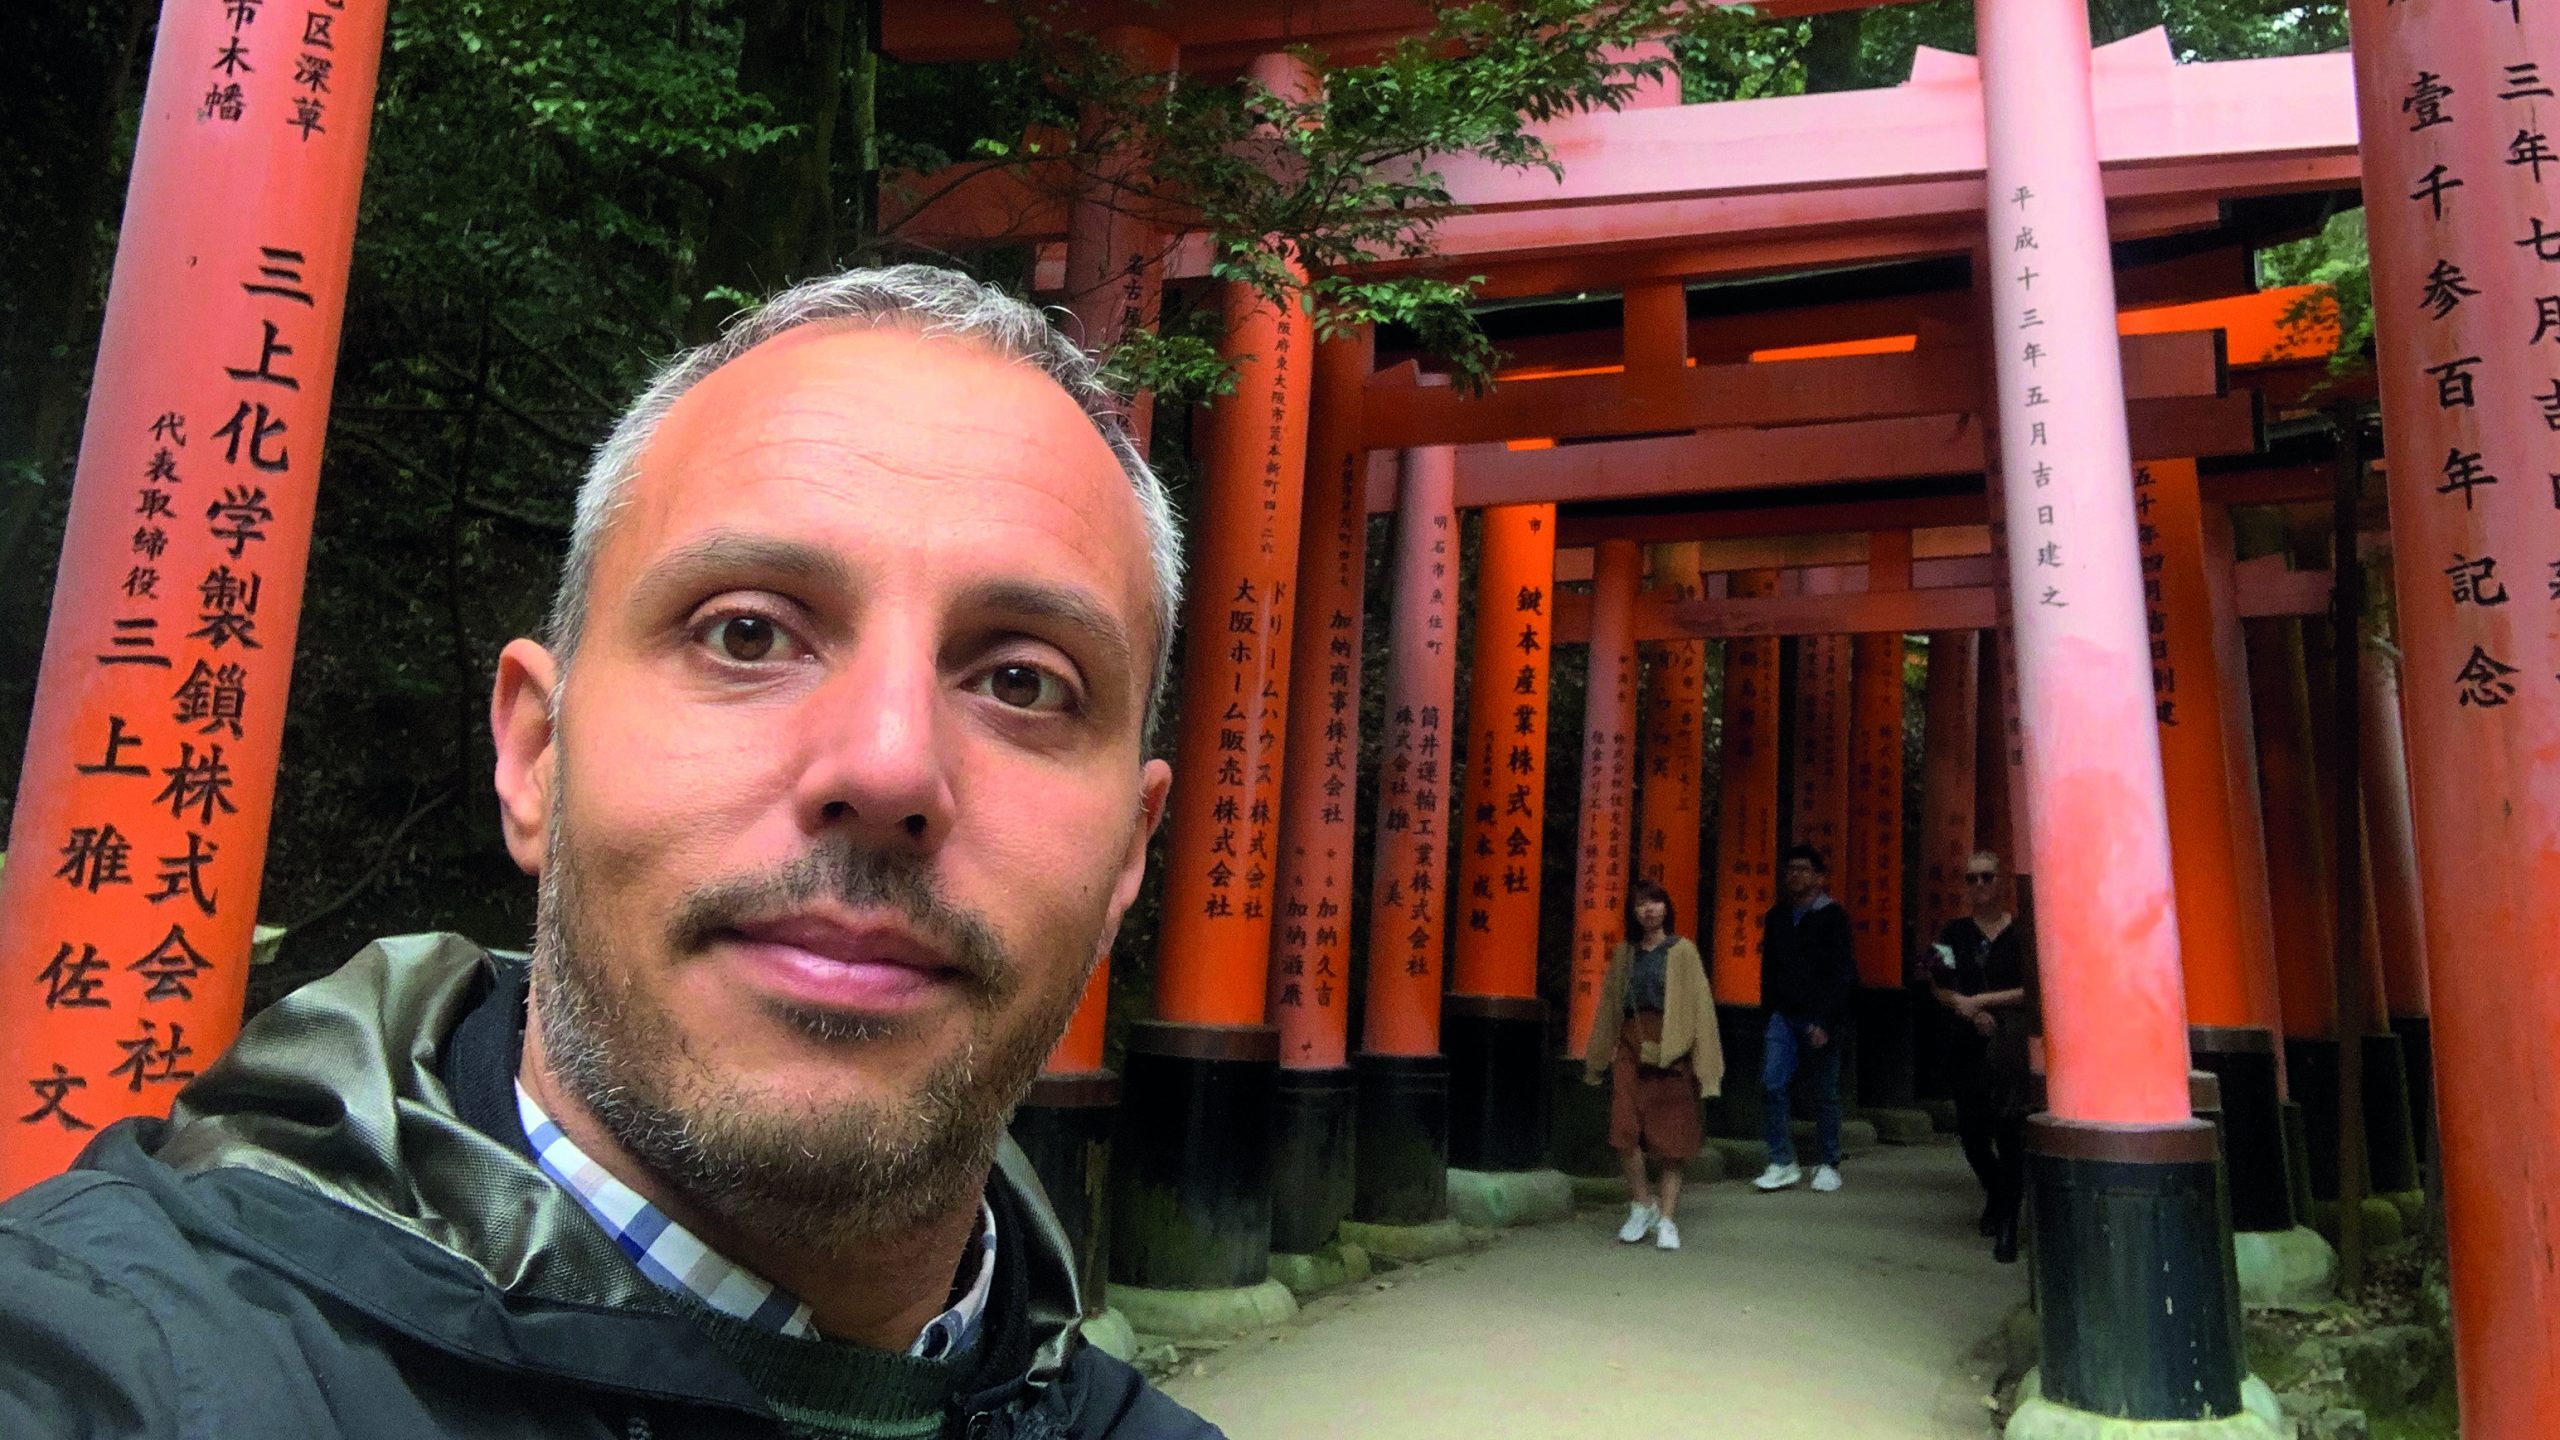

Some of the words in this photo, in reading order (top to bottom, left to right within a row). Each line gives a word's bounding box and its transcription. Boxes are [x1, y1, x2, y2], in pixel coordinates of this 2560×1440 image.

[286, 0, 346, 142] 区深草
[2011, 186, 2069, 608] 平成十三年五月吉日建之
[109, 246, 315, 1093] 三上化学製鎖株式会社
[1204, 577, 1257, 920] 大阪ホーム販売株式会社
[1243, 582, 1287, 920] ドリームハウス株式会社
[1320, 609, 1352, 824] 加納商事株式会社
[1503, 586, 1543, 895] 鍵本産業株式会社
[20, 618, 172, 1131] 三上雅佐文
[1406, 704, 1440, 978] 筒井運輸工業株式会社
